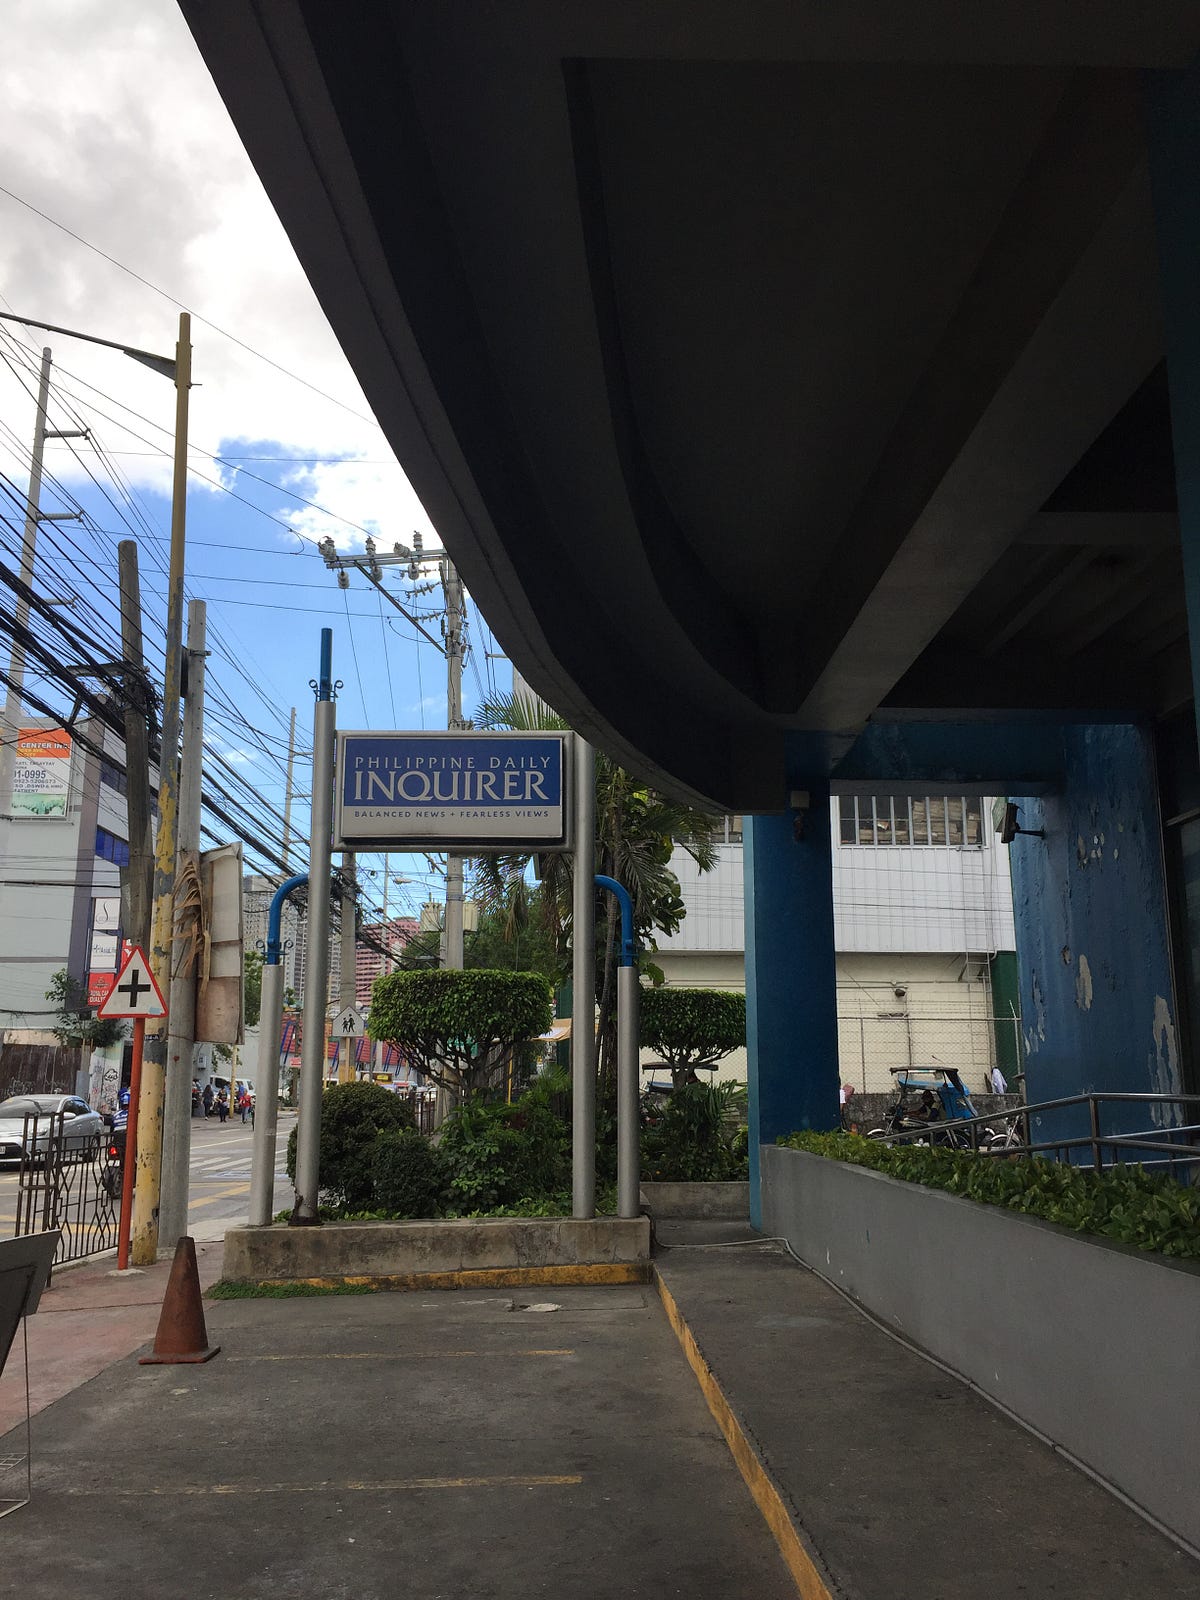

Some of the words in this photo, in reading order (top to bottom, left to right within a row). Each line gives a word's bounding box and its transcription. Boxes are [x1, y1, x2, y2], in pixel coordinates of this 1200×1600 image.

[354, 756, 475, 769] PHILIPPINE
[490, 756, 551, 769] DAILY
[354, 770, 549, 801] INQUIRER
